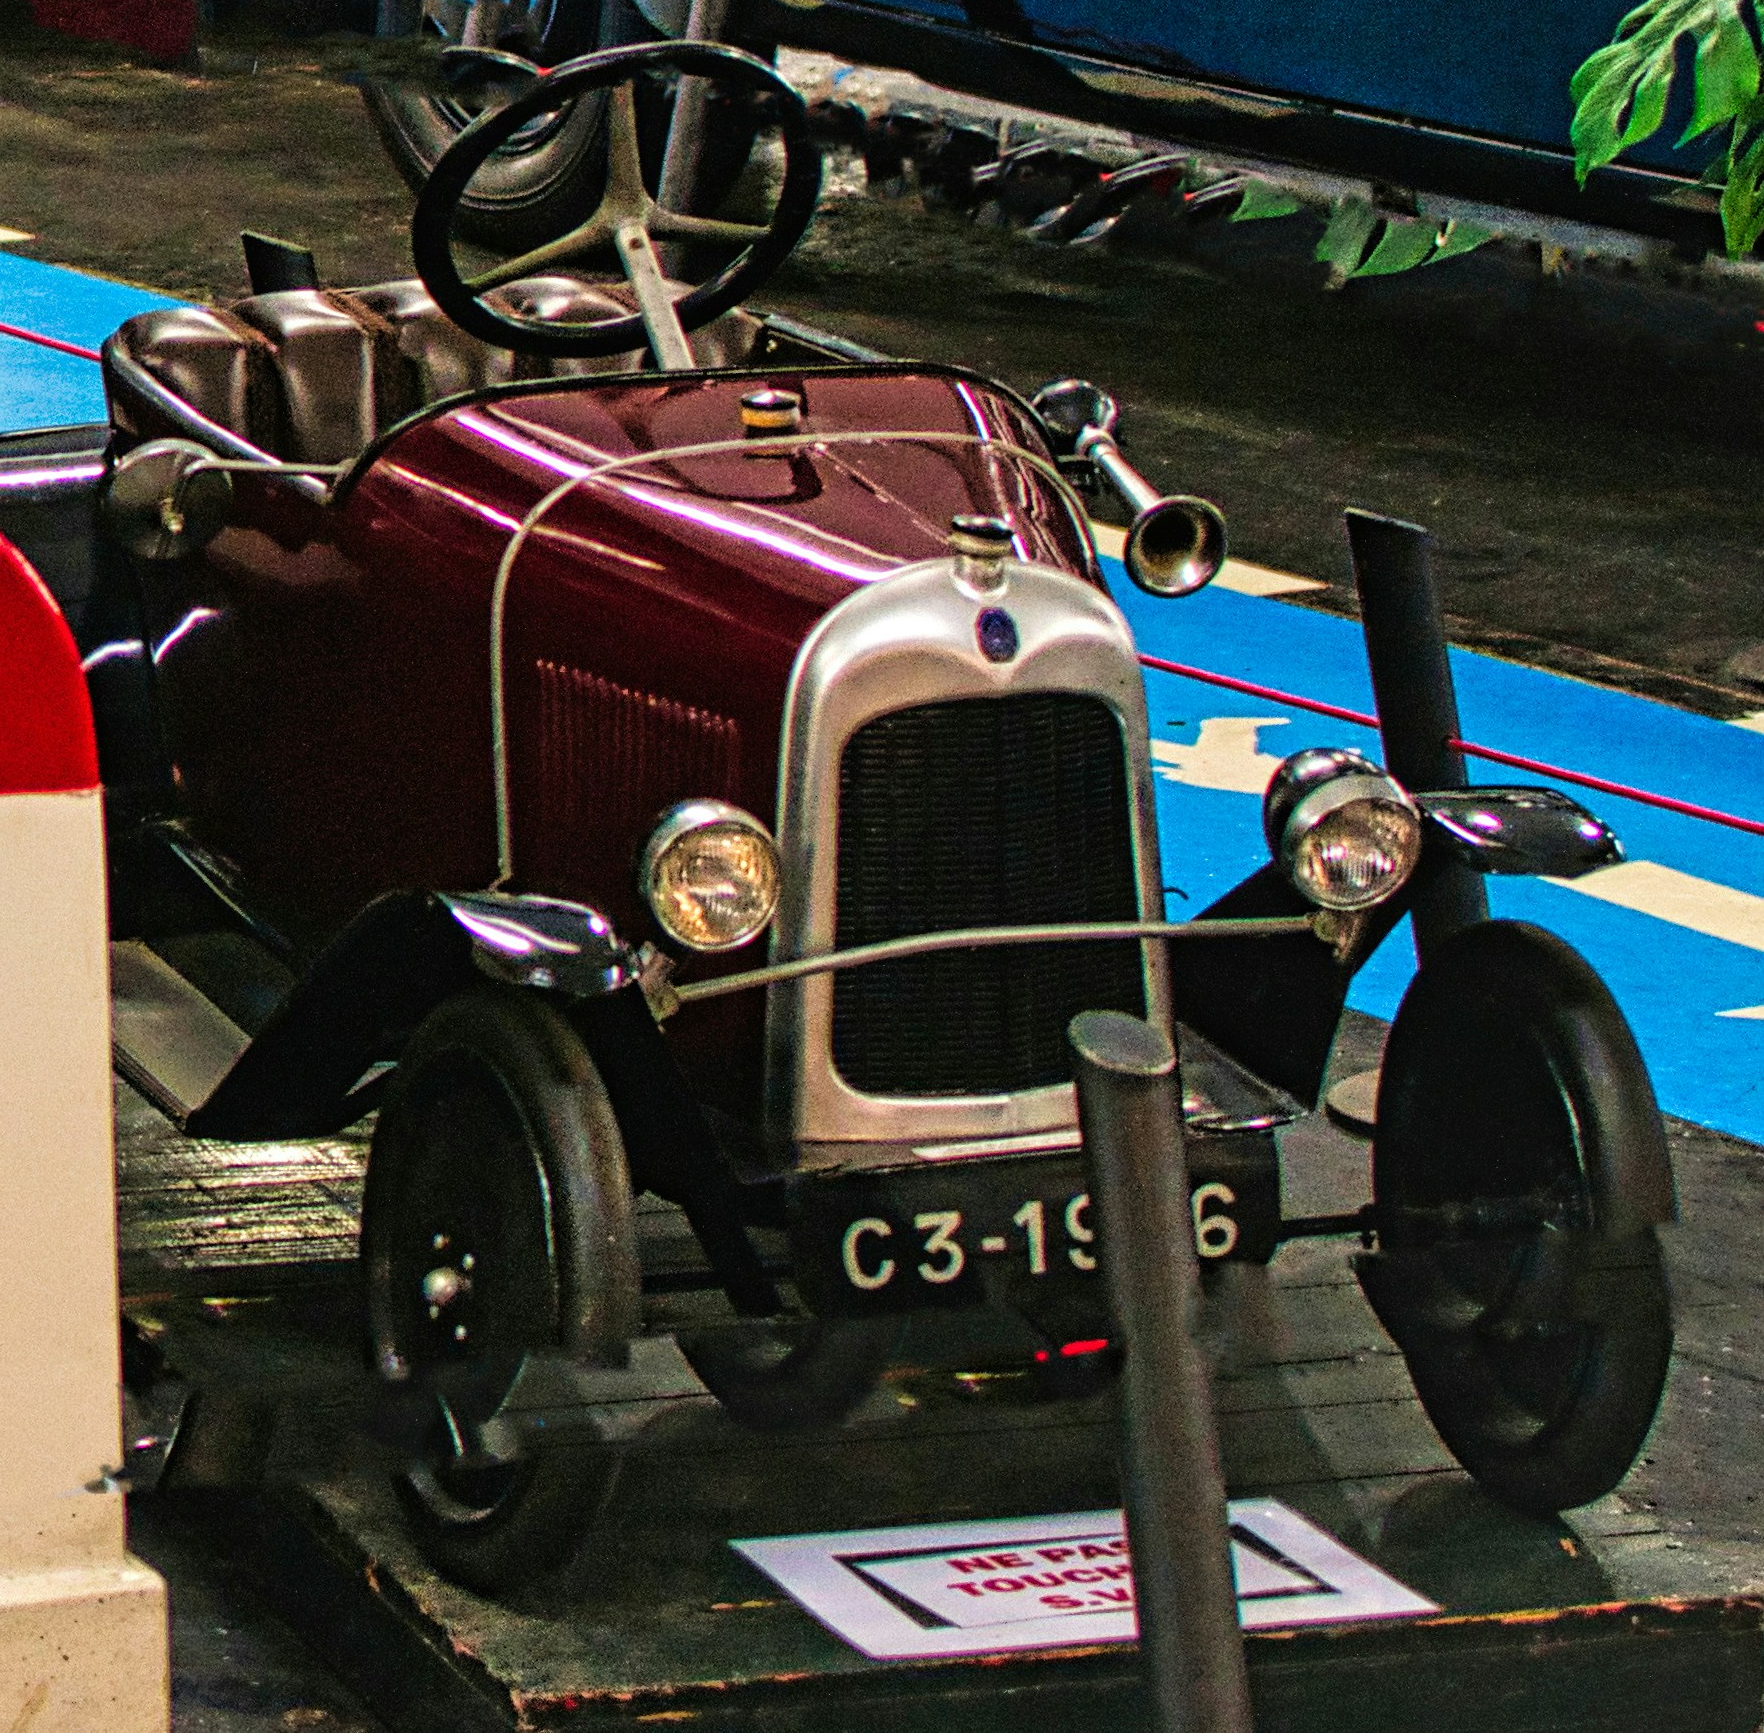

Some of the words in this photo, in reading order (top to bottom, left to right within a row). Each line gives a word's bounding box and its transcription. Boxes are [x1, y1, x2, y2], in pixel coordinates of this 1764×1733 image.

[842, 1182, 1240, 1291] C3-196
[945, 1552, 1034, 1574] NE
[946, 1564, 1133, 1598] TOUCH
